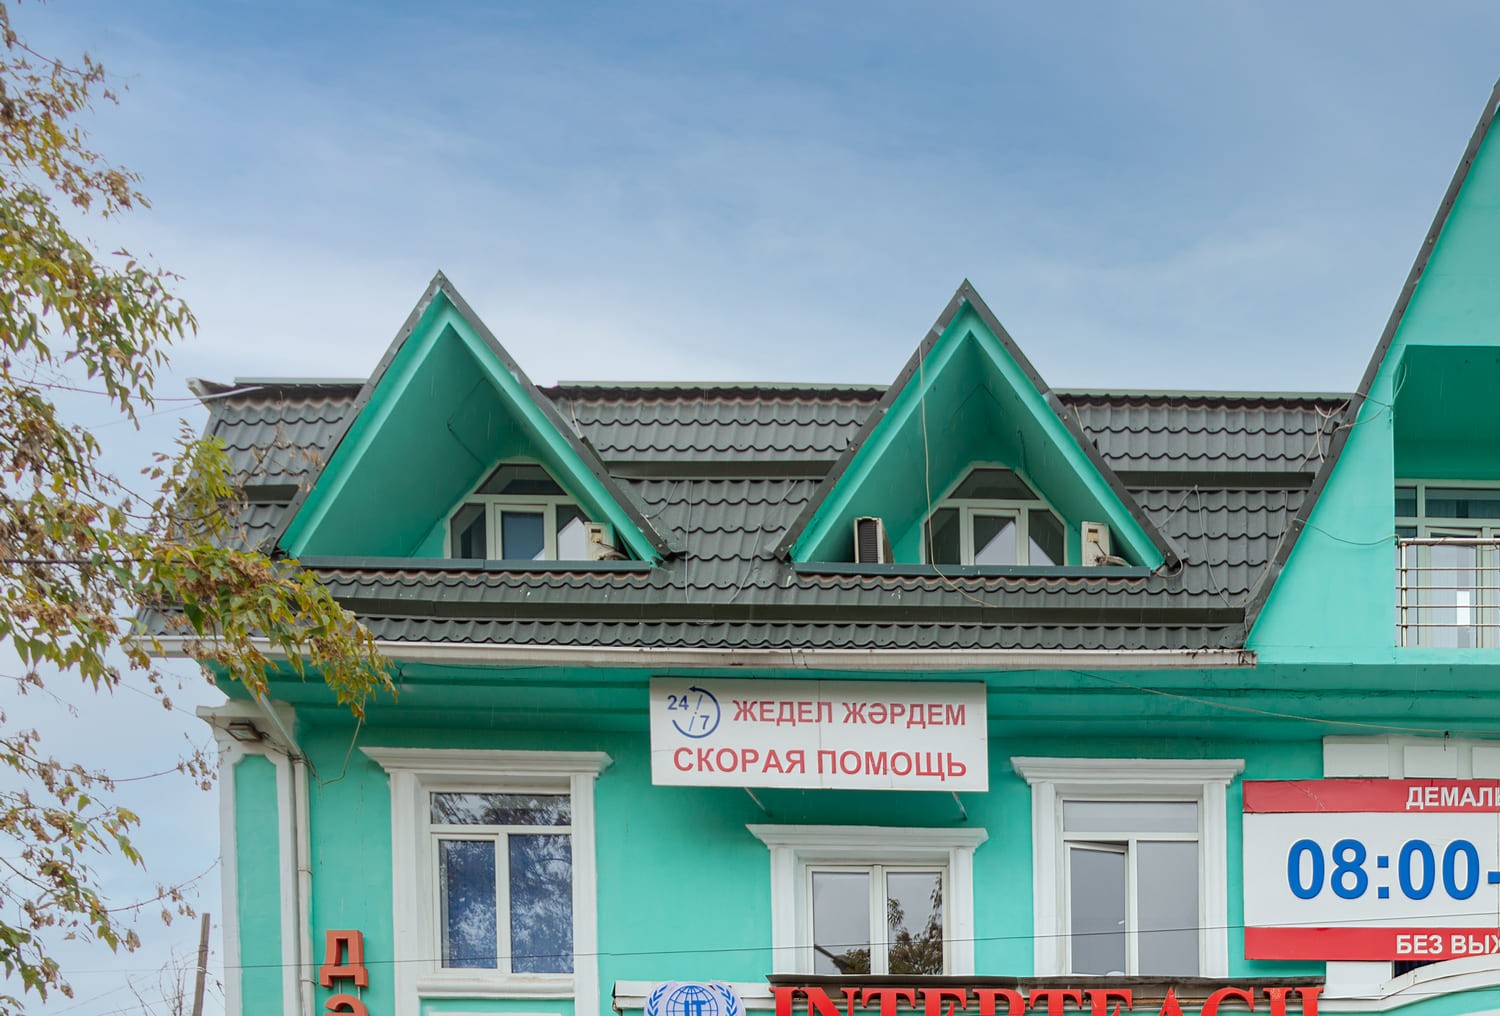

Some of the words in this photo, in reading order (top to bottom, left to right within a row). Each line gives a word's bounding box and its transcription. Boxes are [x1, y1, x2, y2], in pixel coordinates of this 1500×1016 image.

[732, 700, 833, 727] ЖЕДЕЛ
[842, 702, 966, 729] ЖӘРДЕМ
[673, 747, 806, 774] СКОРАЯ
[817, 750, 967, 781] ПОМОЩЬ
[1396, 934, 1443, 955] БЕЗ
